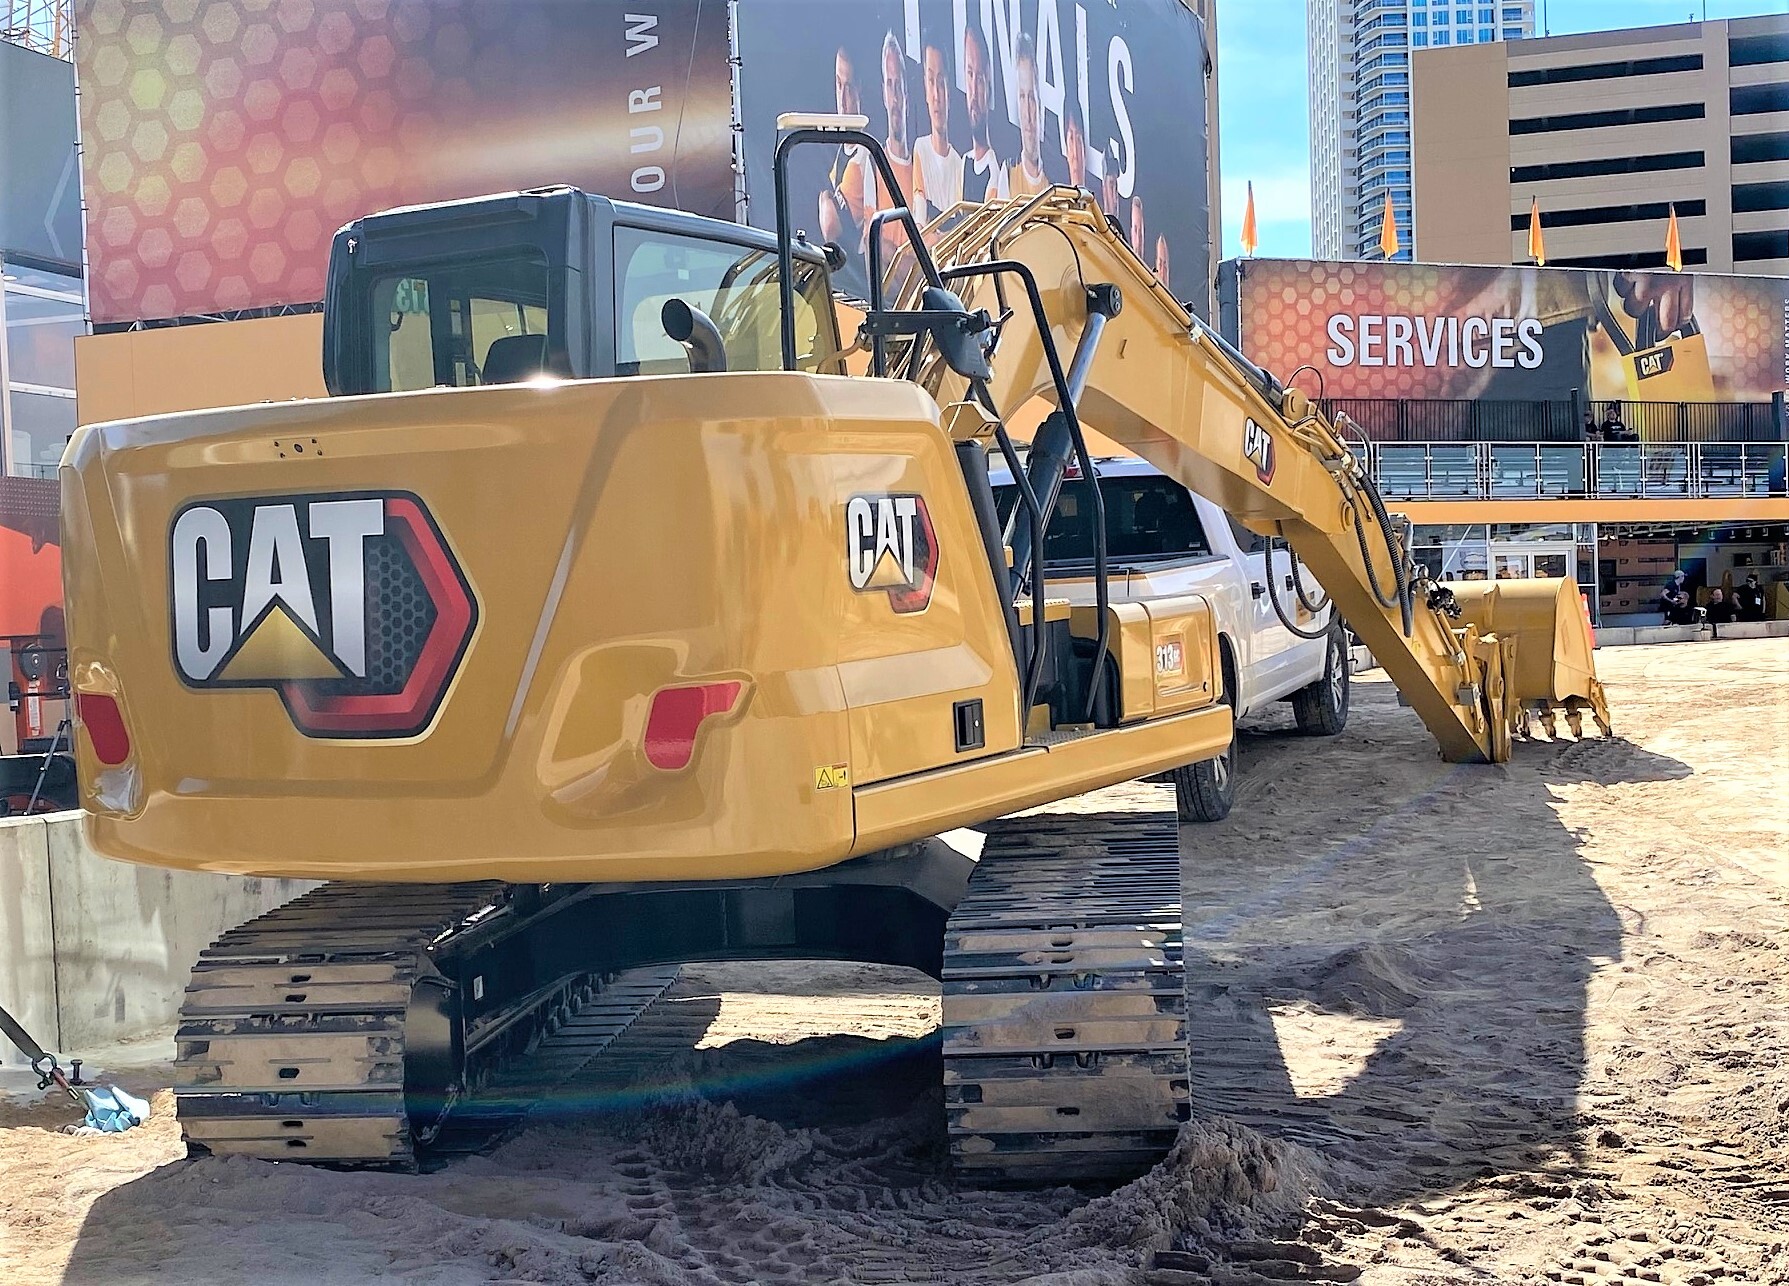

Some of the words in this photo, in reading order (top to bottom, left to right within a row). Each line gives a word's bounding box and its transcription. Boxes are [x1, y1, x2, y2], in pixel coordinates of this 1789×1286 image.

[628, 85, 666, 193] OUR
[1326, 314, 1544, 369] SERVICES
[1640, 352, 1664, 376] CAT
[1244, 418, 1272, 472] CAT
[847, 497, 917, 589] CAT
[172, 499, 385, 681] CAT
[1156, 643, 1174, 672] 313
